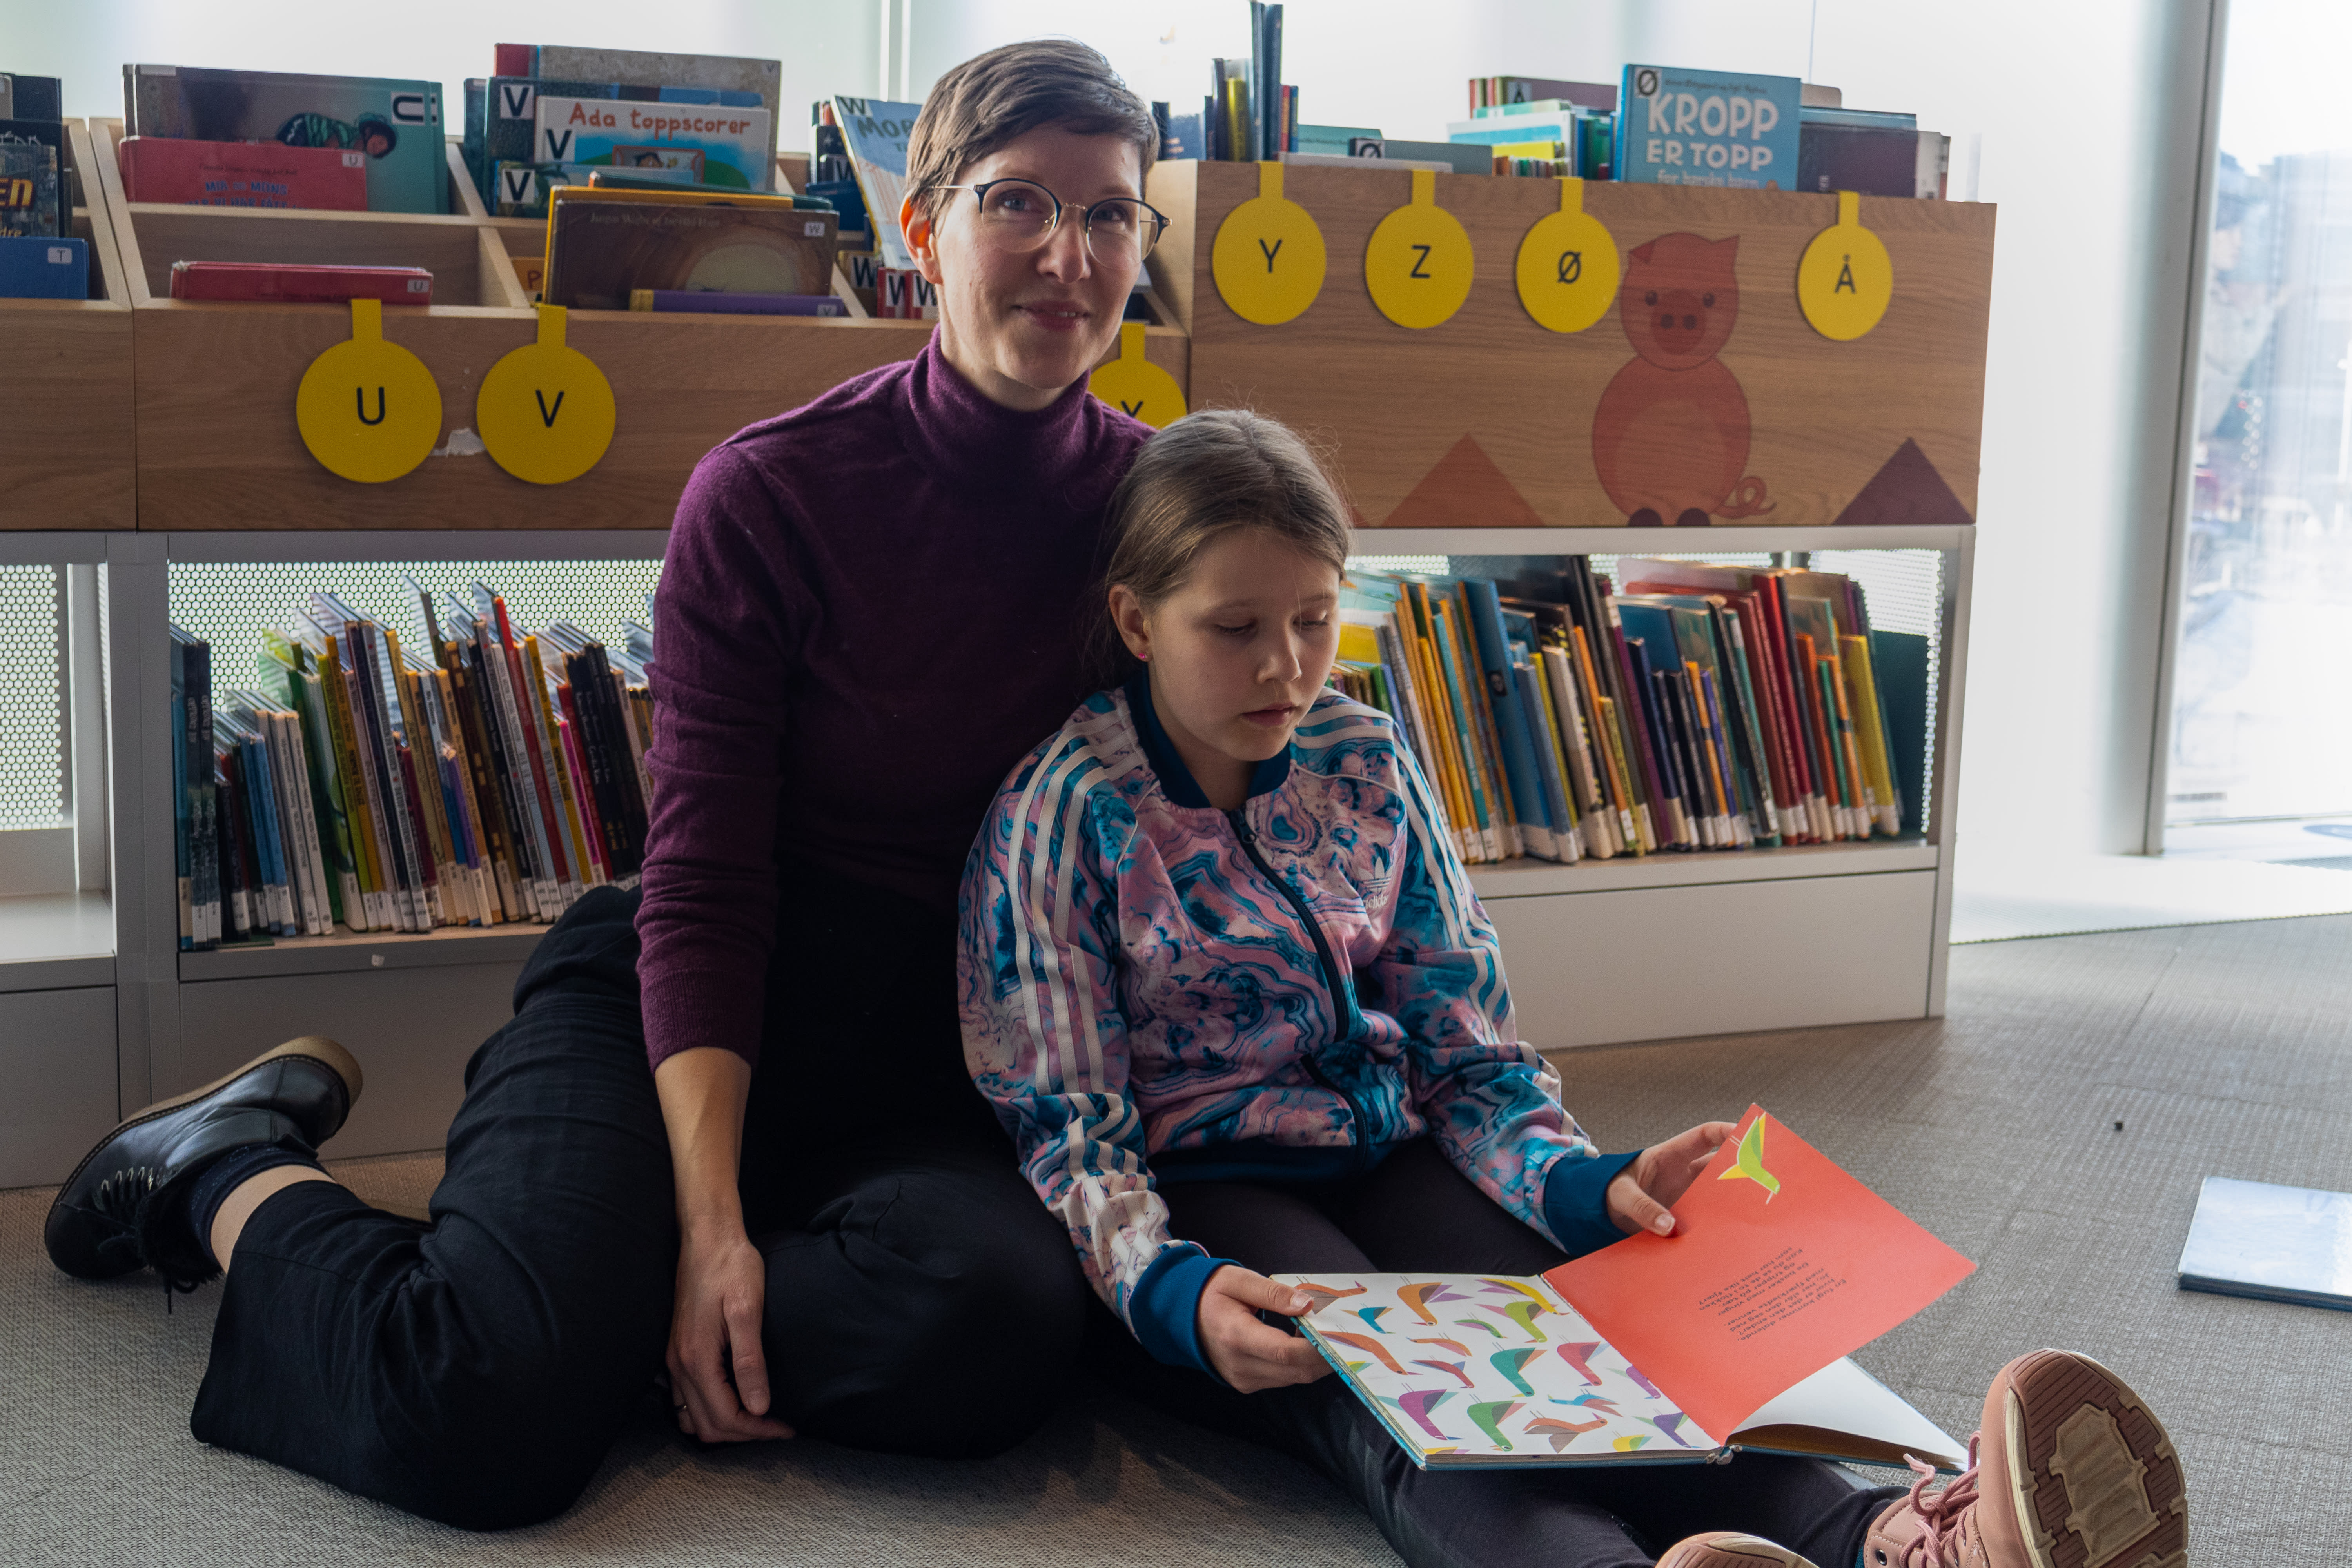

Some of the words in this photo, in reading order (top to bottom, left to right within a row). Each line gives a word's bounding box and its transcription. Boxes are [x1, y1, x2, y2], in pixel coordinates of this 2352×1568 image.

[1637, 69, 1659, 96] Ø
[503, 87, 530, 117] V
[840, 98, 866, 115] W
[568, 103, 616, 127] Ada
[630, 109, 751, 140] toppscorer
[1648, 93, 1779, 140] KROPP
[547, 129, 572, 160] V
[349, 157, 358, 166] U
[1647, 139, 1684, 166] ER
[1690, 143, 1773, 171] TOPP
[205, 181, 229, 192] MIA
[505, 171, 530, 201] V
[809, 225, 820, 233] W
[56, 249, 66, 261] T
[1258, 238, 1283, 274] Y
[1410, 245, 1432, 279] Z
[1557, 250, 1581, 284] Ø
[1834, 254, 1857, 294] Å
[414, 281, 423, 290] U
[357, 387, 385, 426] U
[535, 389, 564, 428] V
[1775, 1247, 1793, 1260] som
[1773, 1261, 1784, 1270] du
[1783, 1262, 1795, 1270] og
[1740, 1271, 1759, 1282] helt
[1754, 1271, 1783, 1290] tripper
[1768, 1270, 1796, 1289] basker
[1805, 1268, 1824, 1282] med
[1802, 1282, 1817, 1292] her
[1816, 1278, 1835, 1292] hvor
[1699, 1291, 1722, 1305] fjær?
[1746, 1289, 1765, 1302] med
[1758, 1282, 1804, 1309] fjærkledte
[1788, 1298, 1803, 1308] det
[1718, 1301, 1745, 1316] vinger
[1765, 1303, 1782, 1312] den
[1769, 1308, 1786, 1318] den
[1779, 1299, 1815, 1321] kommer
[1724, 1309, 1756, 1326] venner.
[1748, 1312, 1764, 1321] seg
[1730, 1321, 1747, 1332] ned
[1739, 1318, 1768, 1335] ender?
